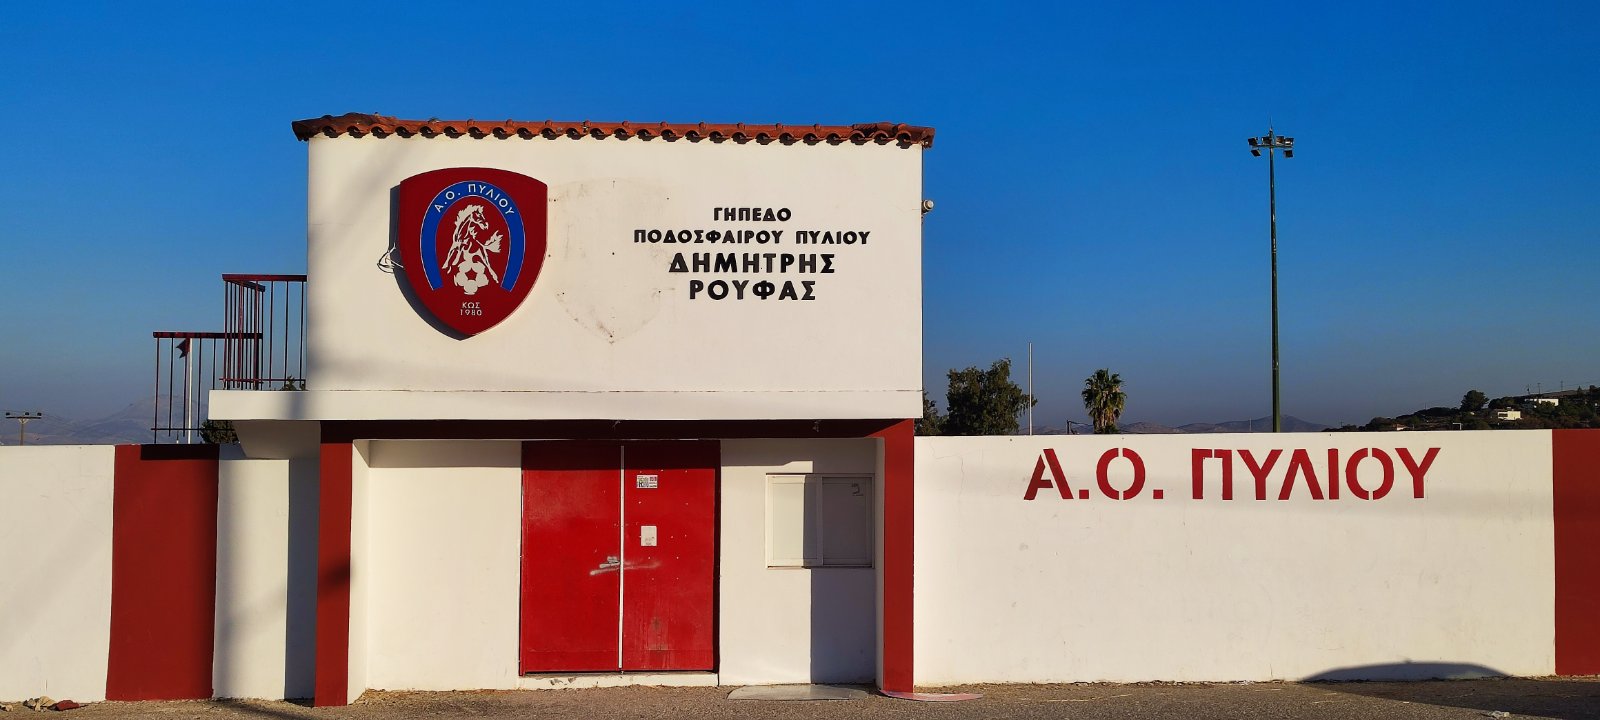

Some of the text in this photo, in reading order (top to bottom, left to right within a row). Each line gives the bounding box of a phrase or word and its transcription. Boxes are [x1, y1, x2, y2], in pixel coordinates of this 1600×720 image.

[434, 183, 515, 215] Α.Ο. ΠΥΛΙΟΥ
[713, 207, 792, 222] ΓΗΠΕΔΟ
[633, 229, 871, 245] ΠΟΔΟΣΦΑΙΡΟΥ ΠΥΛΙΟΥ
[669, 253, 835, 273] ΔΗΜΗΤΡΗΣ
[689, 280, 816, 300] ΡΟΥΦΑΣ
[462, 301, 481, 309] ΚΩΣ
[1023, 447, 1441, 501] Α.Ο. ΠΥΛΙΟΥ
